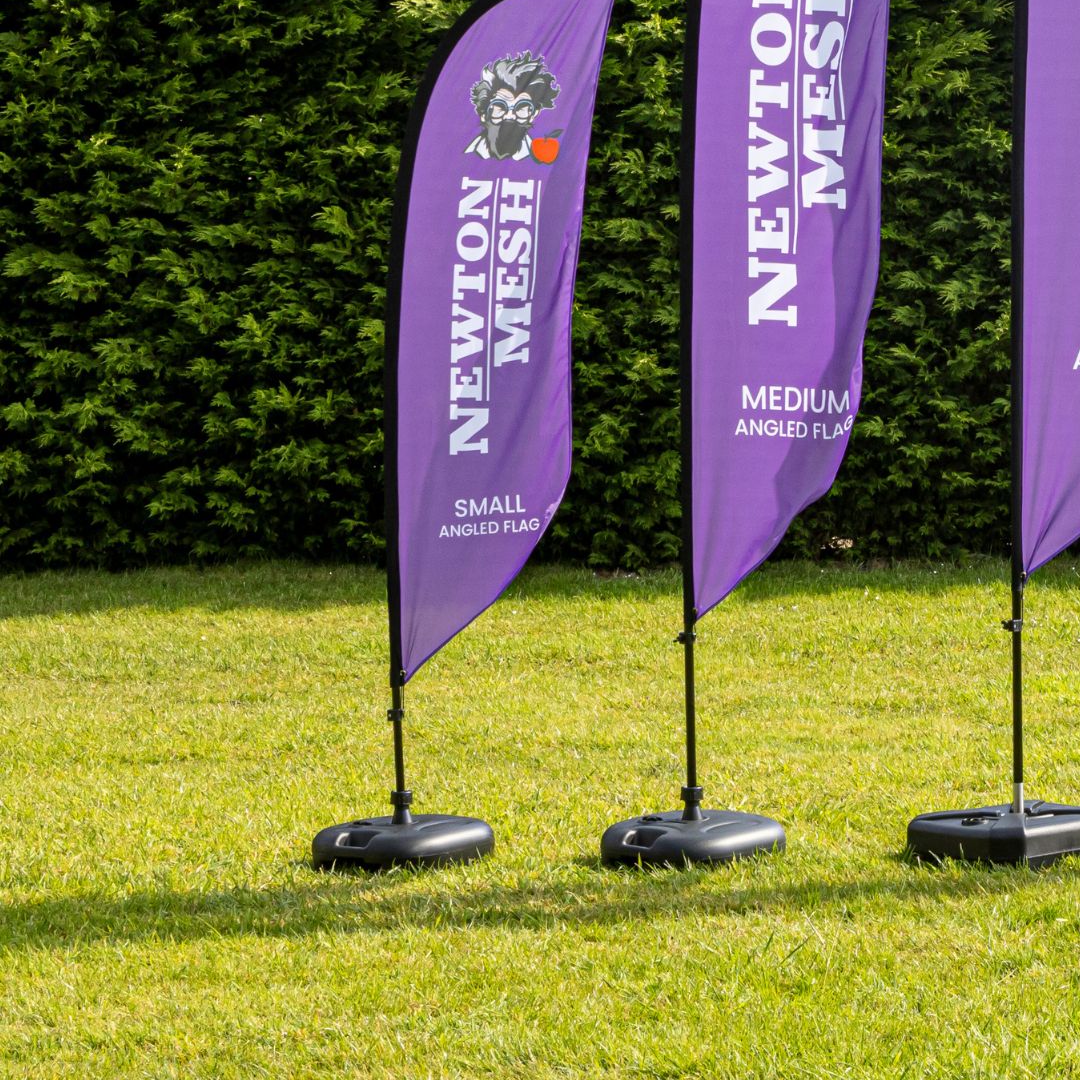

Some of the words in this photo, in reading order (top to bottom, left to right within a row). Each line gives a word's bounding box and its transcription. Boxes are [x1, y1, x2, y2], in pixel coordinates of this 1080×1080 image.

[494, 177, 535, 367] MESH
[449, 176, 493, 456] NEWTON
[742, 384, 850, 413] MEDIUM
[735, 418, 808, 439] ANGLED
[812, 414, 854, 440] FLAG
[454, 494, 526, 518] SMALL
[438, 520, 499, 538] ANGLED
[503, 517, 540, 534] FLAG
